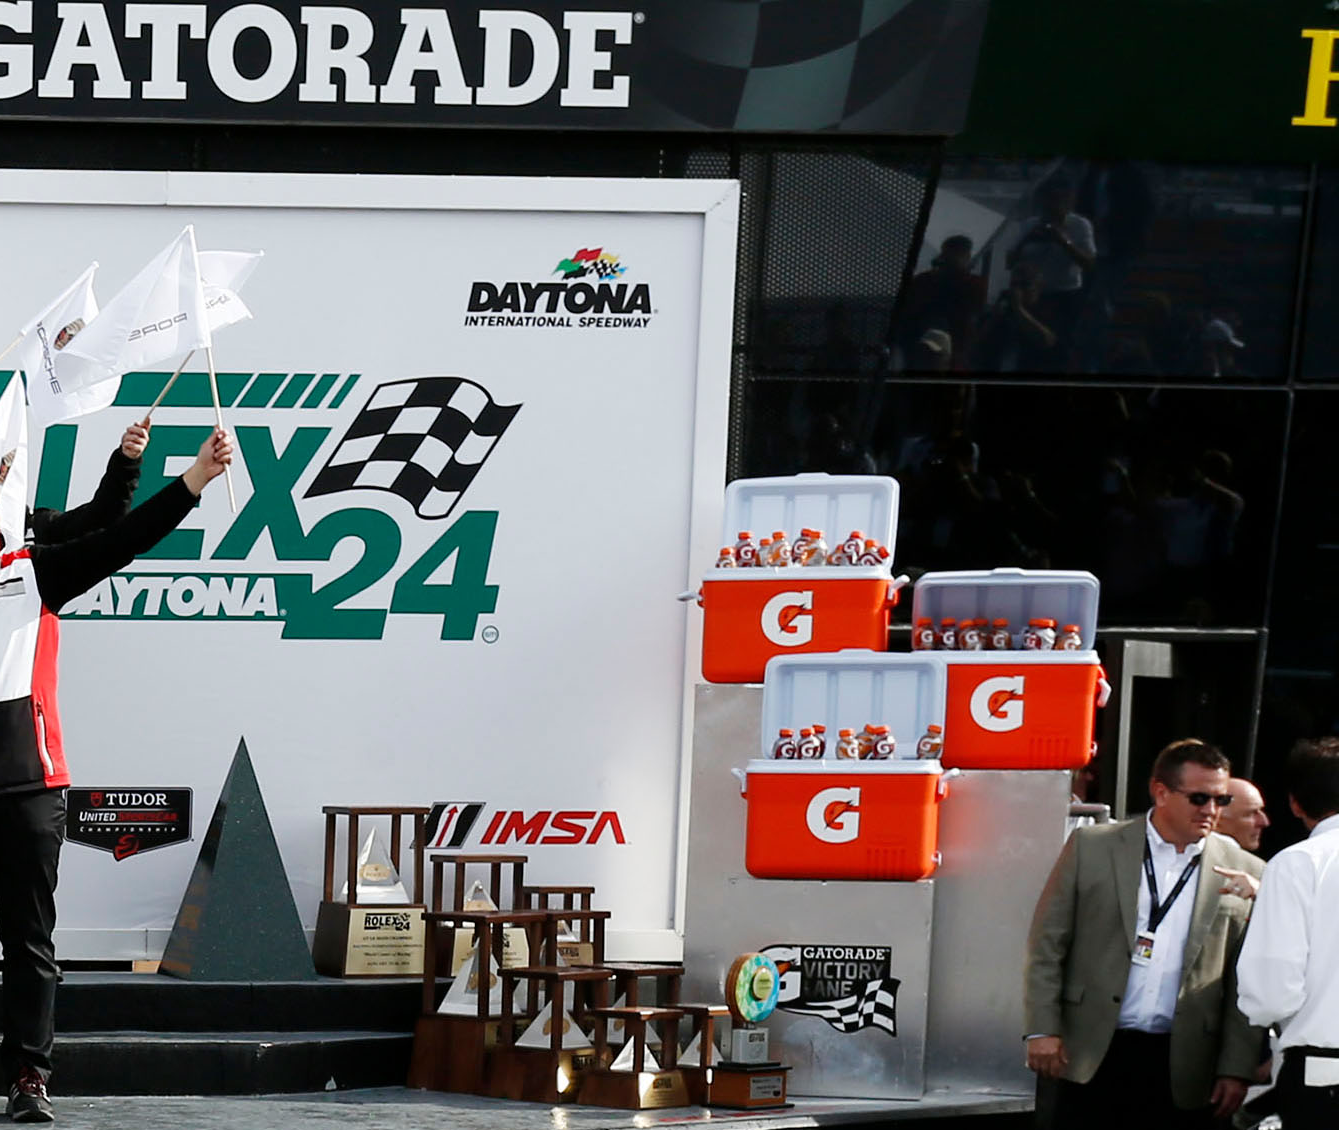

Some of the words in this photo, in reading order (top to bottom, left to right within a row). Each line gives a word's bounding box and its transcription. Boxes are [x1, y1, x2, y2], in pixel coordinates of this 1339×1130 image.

[467, 282, 653, 316] DAYTONA
[464, 315, 573, 328] INTERNATIONAL
[578, 317, 652, 329] SPEEDWAY
[280, 507, 500, 641] 24
[58, 575, 286, 619] AYTONA
[761, 591, 814, 647] G
[970, 675, 1025, 732] G
[106, 792, 167, 807] TUDOR
[806, 787, 861, 843] G
[79, 811, 116, 823] UNITED
[480, 811, 626, 845] IMSA
[364, 916, 397, 928] ROLEX
[803, 946, 886, 961] GATORADE
[804, 961, 885, 981] VICTORY
